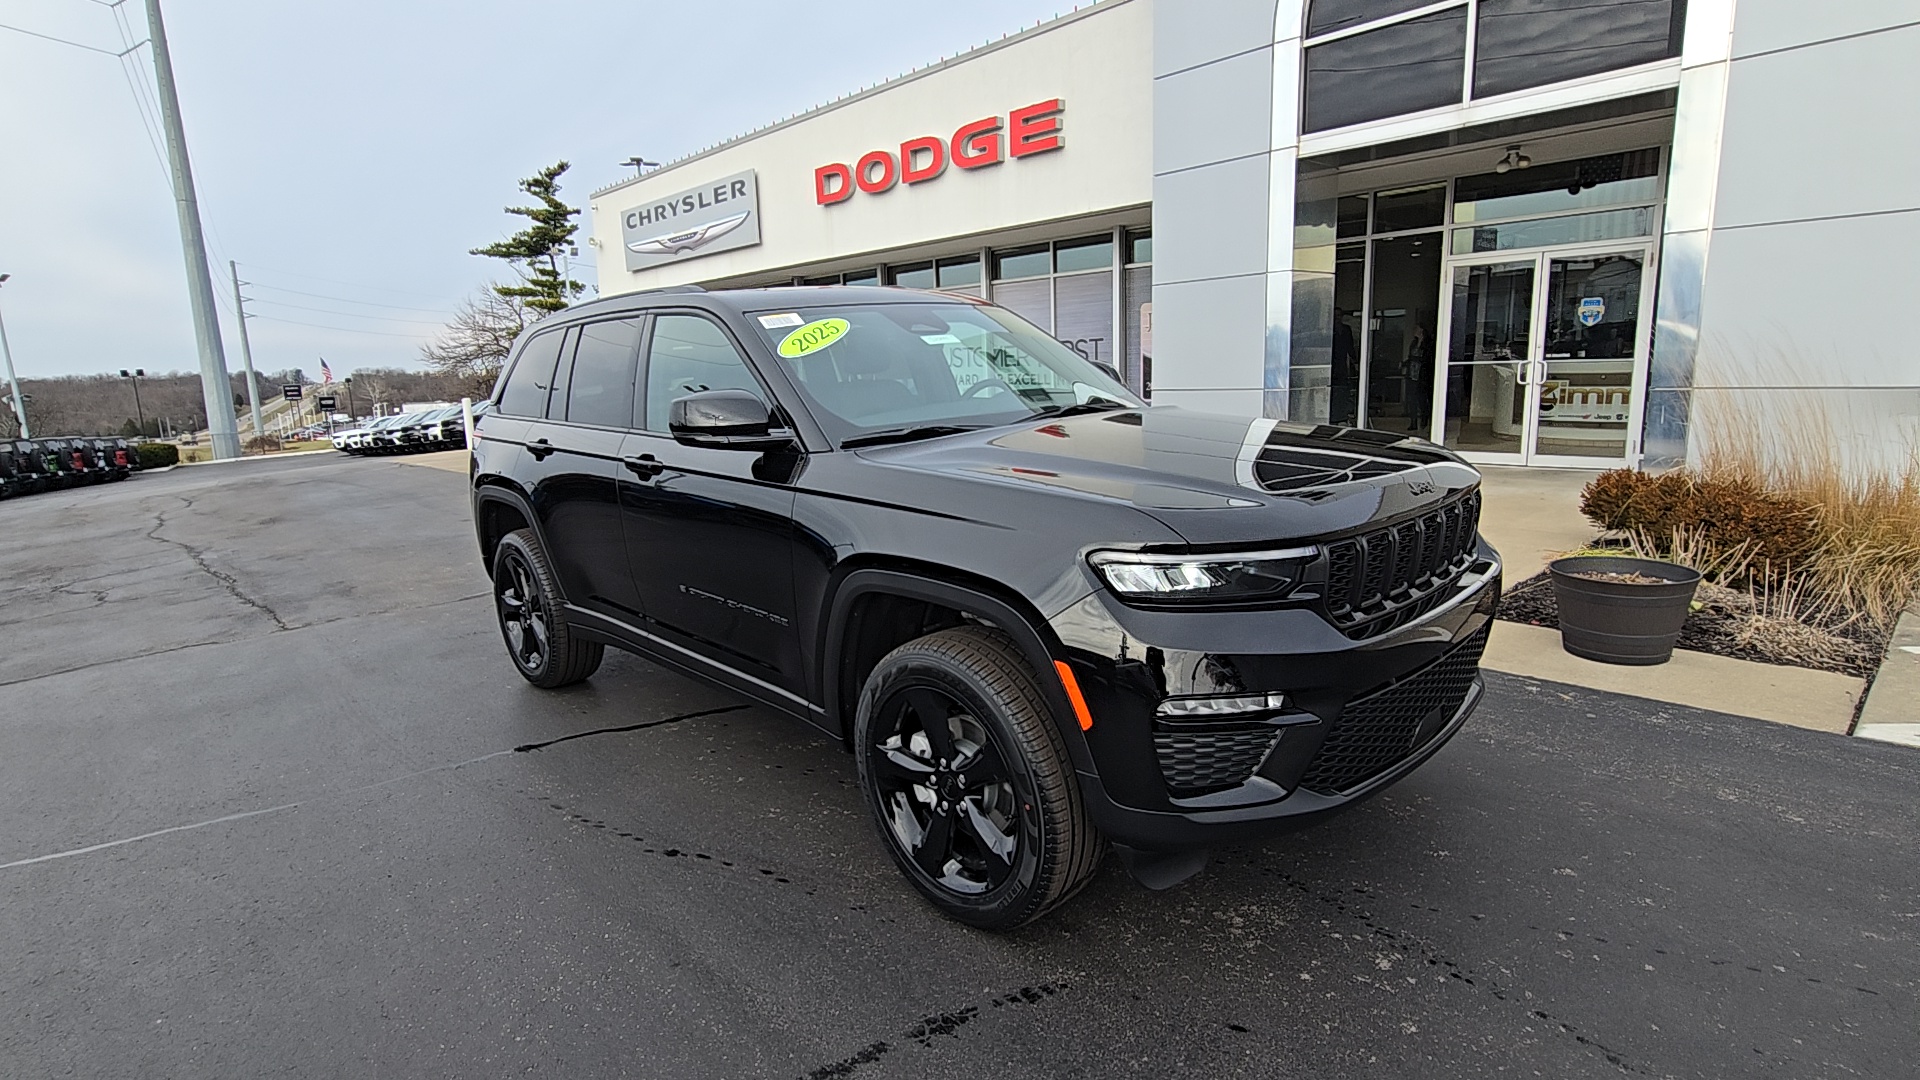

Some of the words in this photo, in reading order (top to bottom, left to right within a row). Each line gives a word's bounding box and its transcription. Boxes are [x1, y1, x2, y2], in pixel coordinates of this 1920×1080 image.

[815, 98, 1064, 205] DODGE
[626, 179, 747, 230] CHRYSLER
[791, 321, 840, 353] 2025
